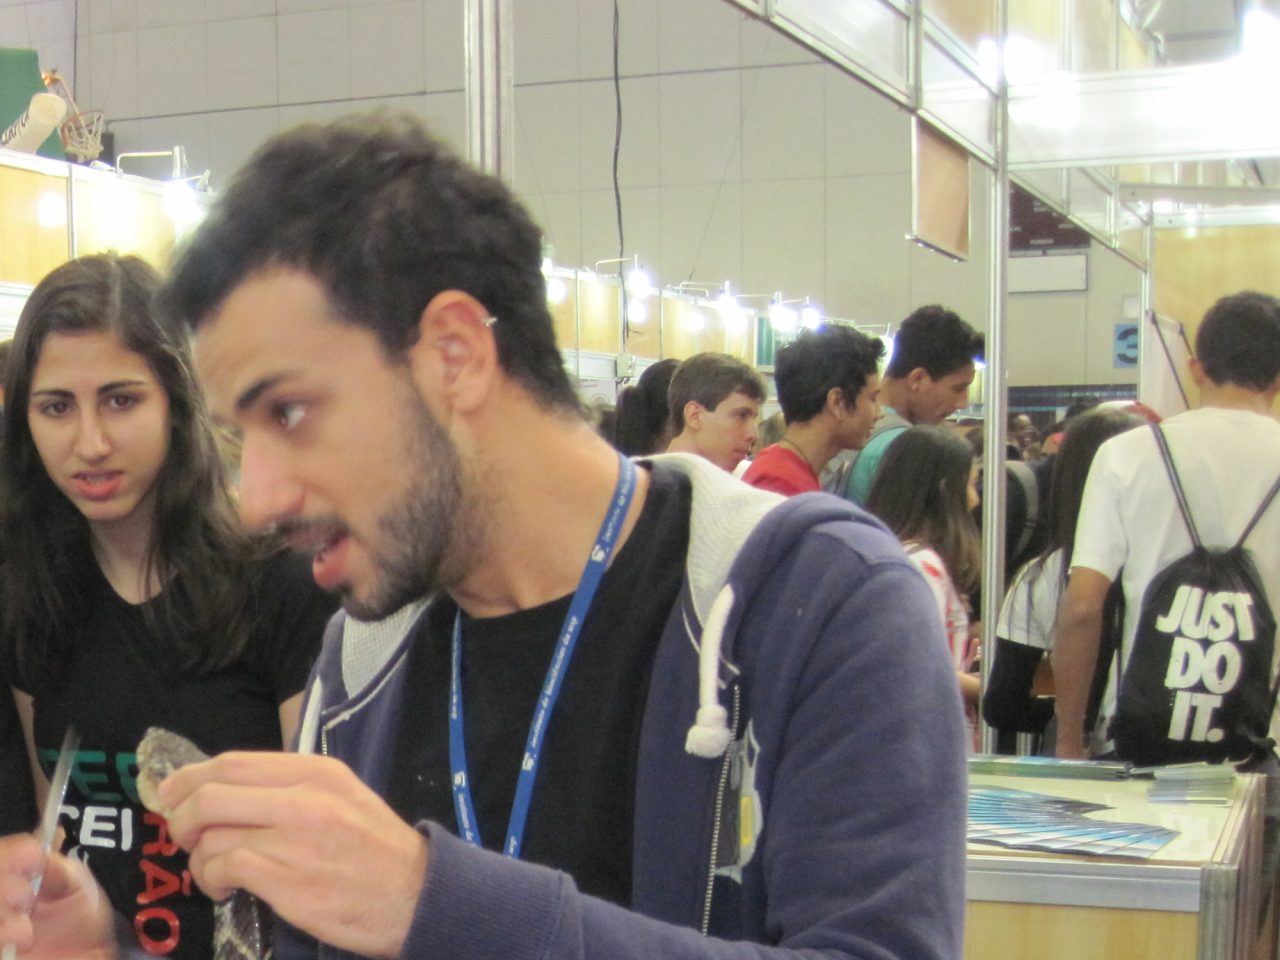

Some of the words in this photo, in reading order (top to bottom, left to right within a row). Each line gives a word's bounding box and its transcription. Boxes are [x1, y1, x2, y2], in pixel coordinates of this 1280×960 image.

[1155, 584, 1256, 641] JUST
[1164, 636, 1242, 694] DO
[1167, 690, 1225, 743] IT.
[58, 804, 133, 851] EI
